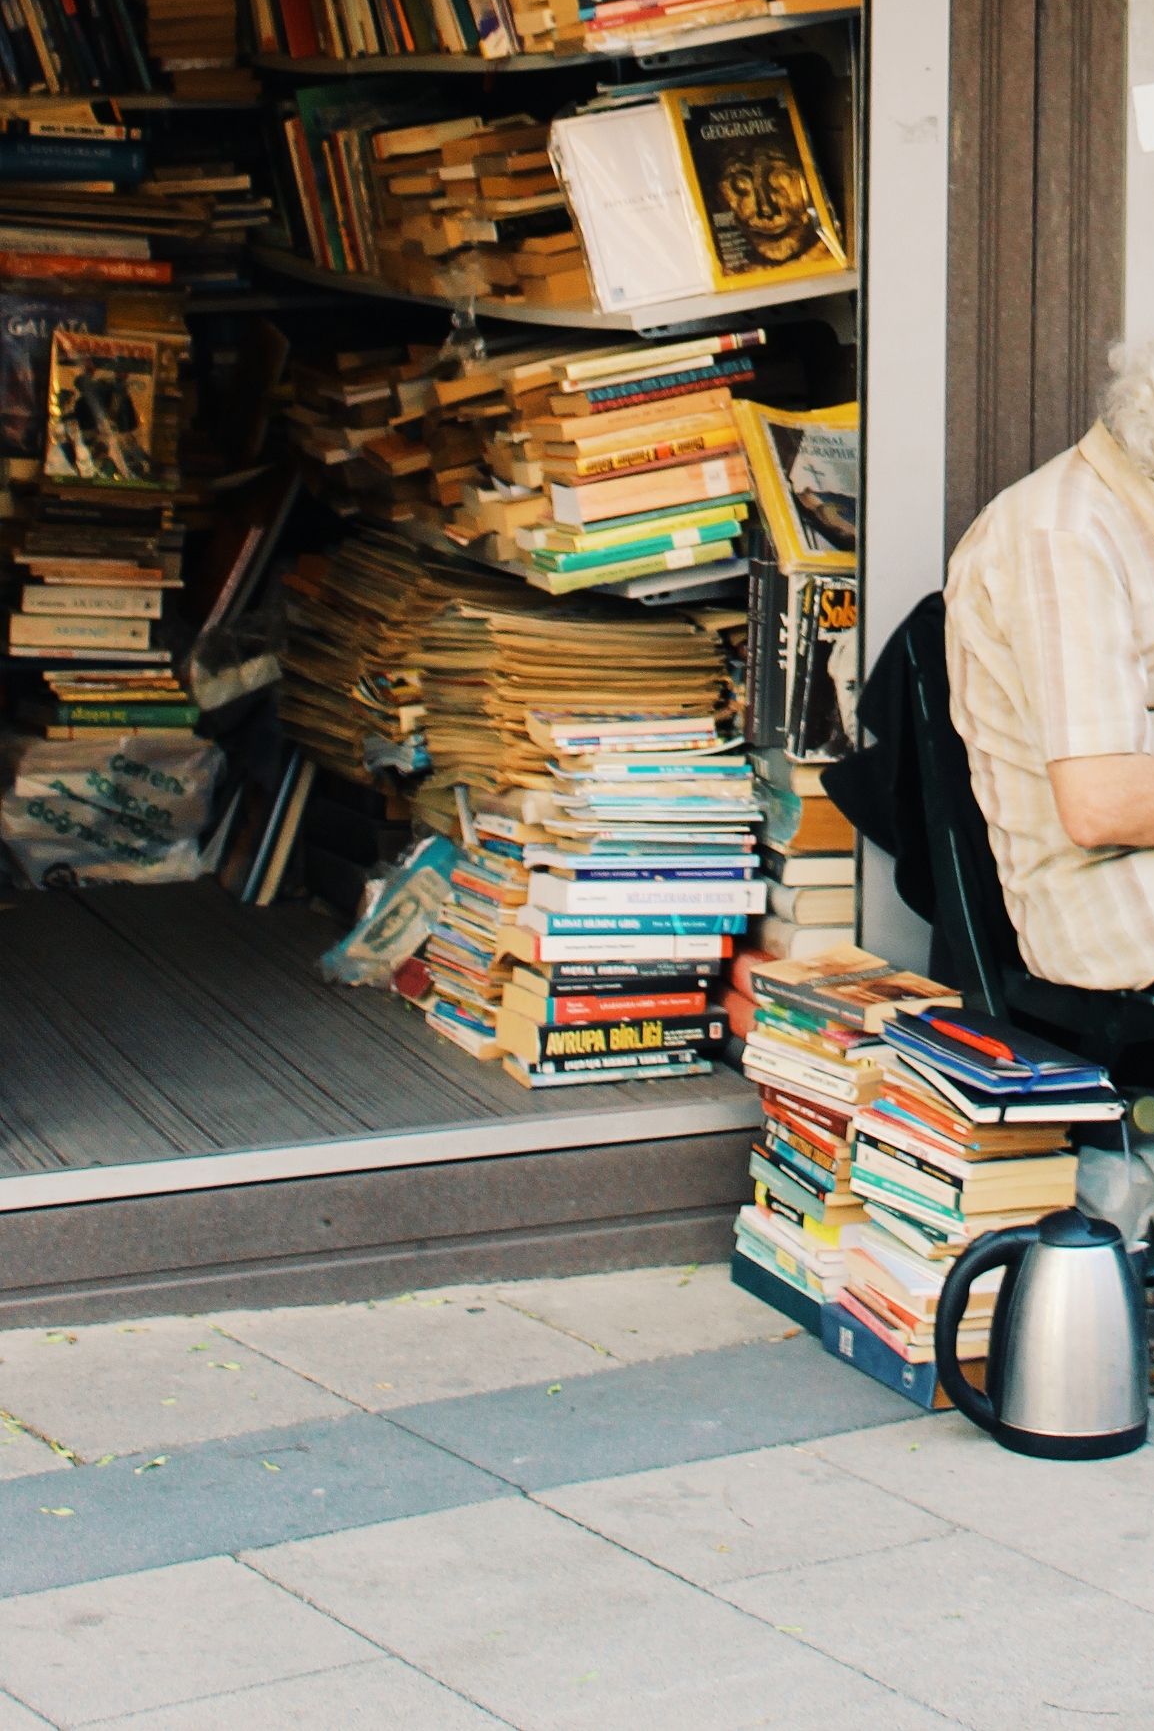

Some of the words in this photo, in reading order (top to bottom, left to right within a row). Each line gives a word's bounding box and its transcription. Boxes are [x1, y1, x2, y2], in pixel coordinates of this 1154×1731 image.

[709, 107, 763, 123] NATIONAL
[700, 118, 778, 142] GEOGRAPHIC
[545, 1029, 607, 1057] AVRUPA
